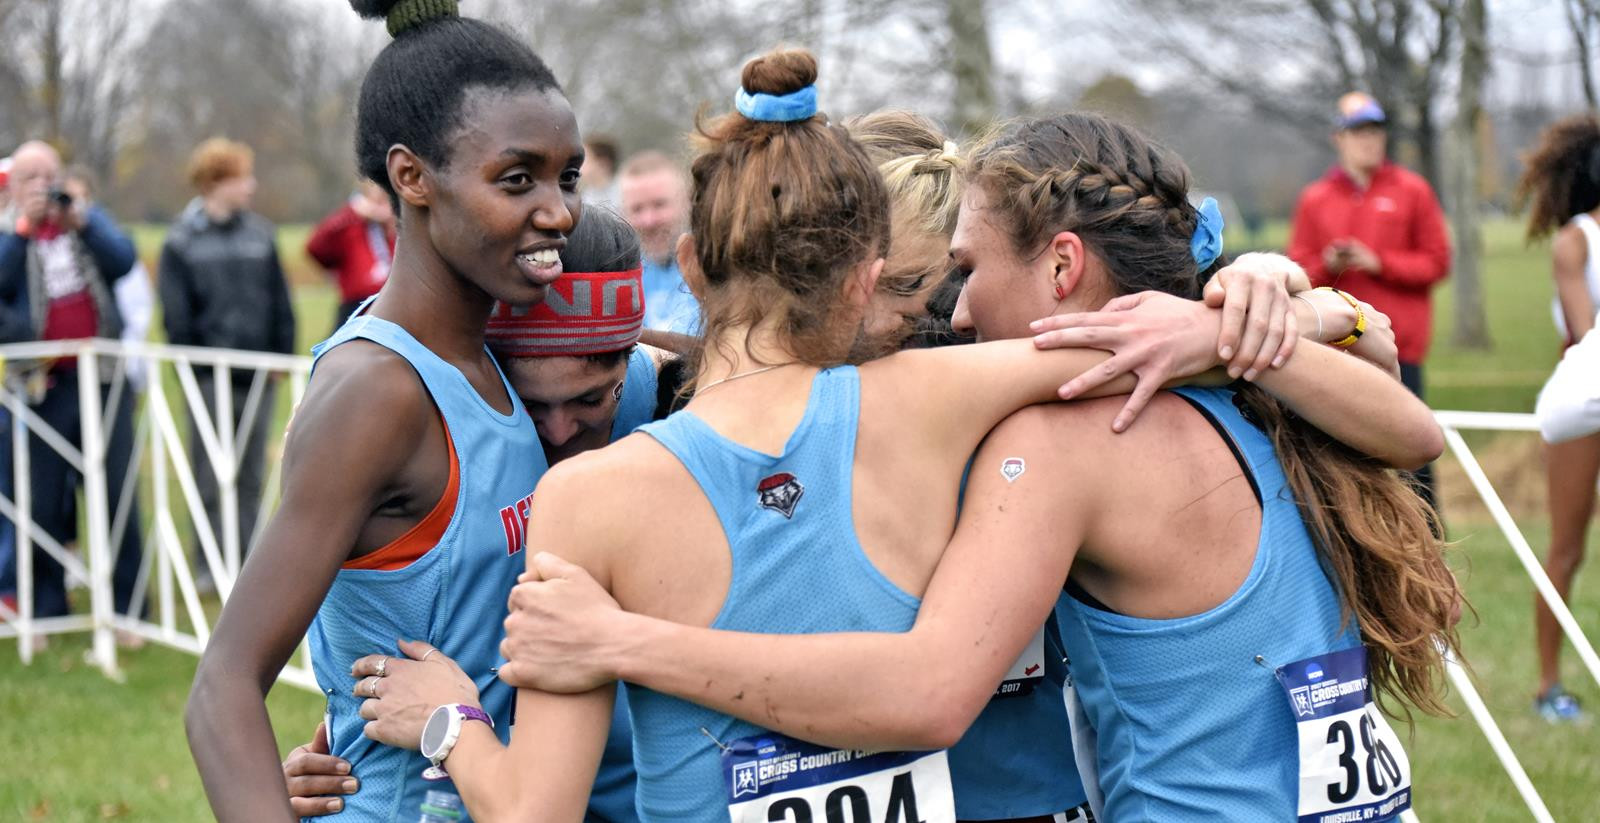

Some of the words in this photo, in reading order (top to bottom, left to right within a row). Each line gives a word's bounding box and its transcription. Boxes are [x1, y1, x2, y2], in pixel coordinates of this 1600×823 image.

[499, 491, 535, 557] NE
[1001, 683, 1021, 693] 2017
[1311, 685, 1340, 703] CROSS
[759, 759, 798, 780] CROSS
[800, 749, 852, 771] COUNTRY
